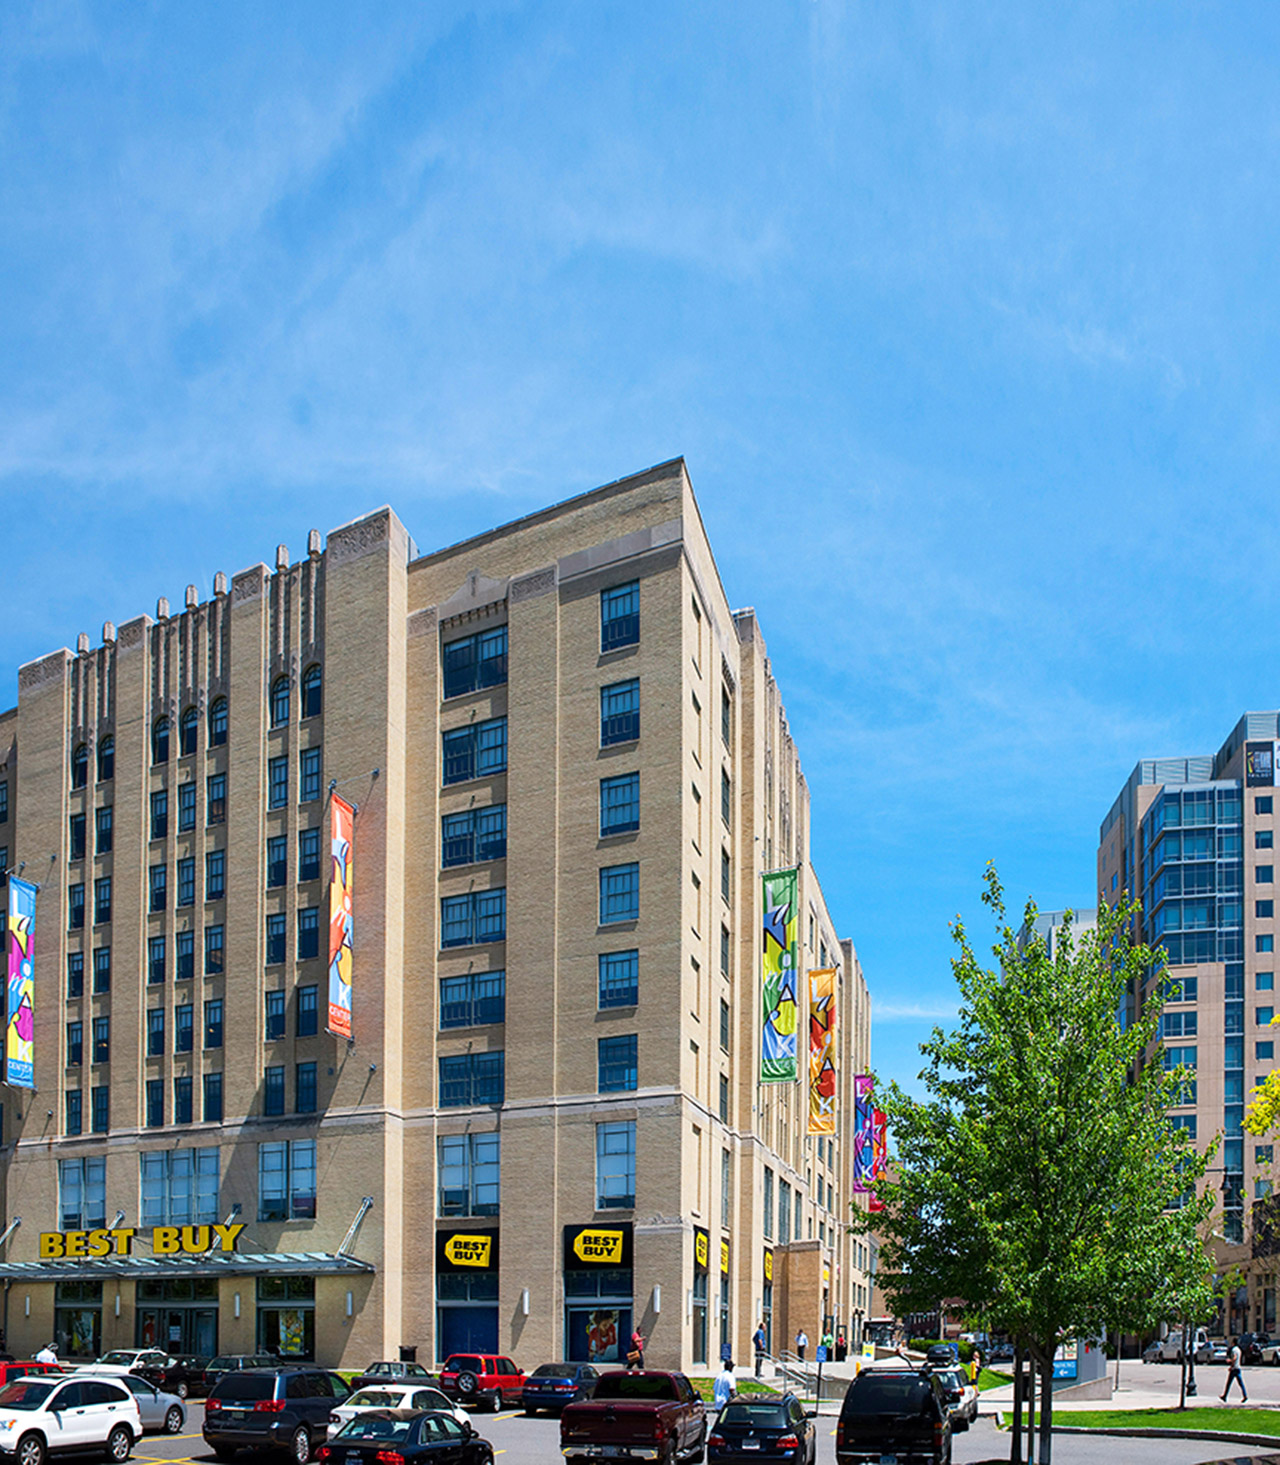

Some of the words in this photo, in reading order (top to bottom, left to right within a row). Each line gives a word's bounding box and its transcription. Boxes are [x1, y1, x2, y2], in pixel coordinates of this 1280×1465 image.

[40, 1228, 136, 1258] BEST
[153, 1224, 246, 1254] BUY
[453, 1240, 488, 1251] BEST
[583, 1235, 620, 1246] BEST
[454, 1250, 484, 1261] BUY
[583, 1246, 616, 1257] BUY
